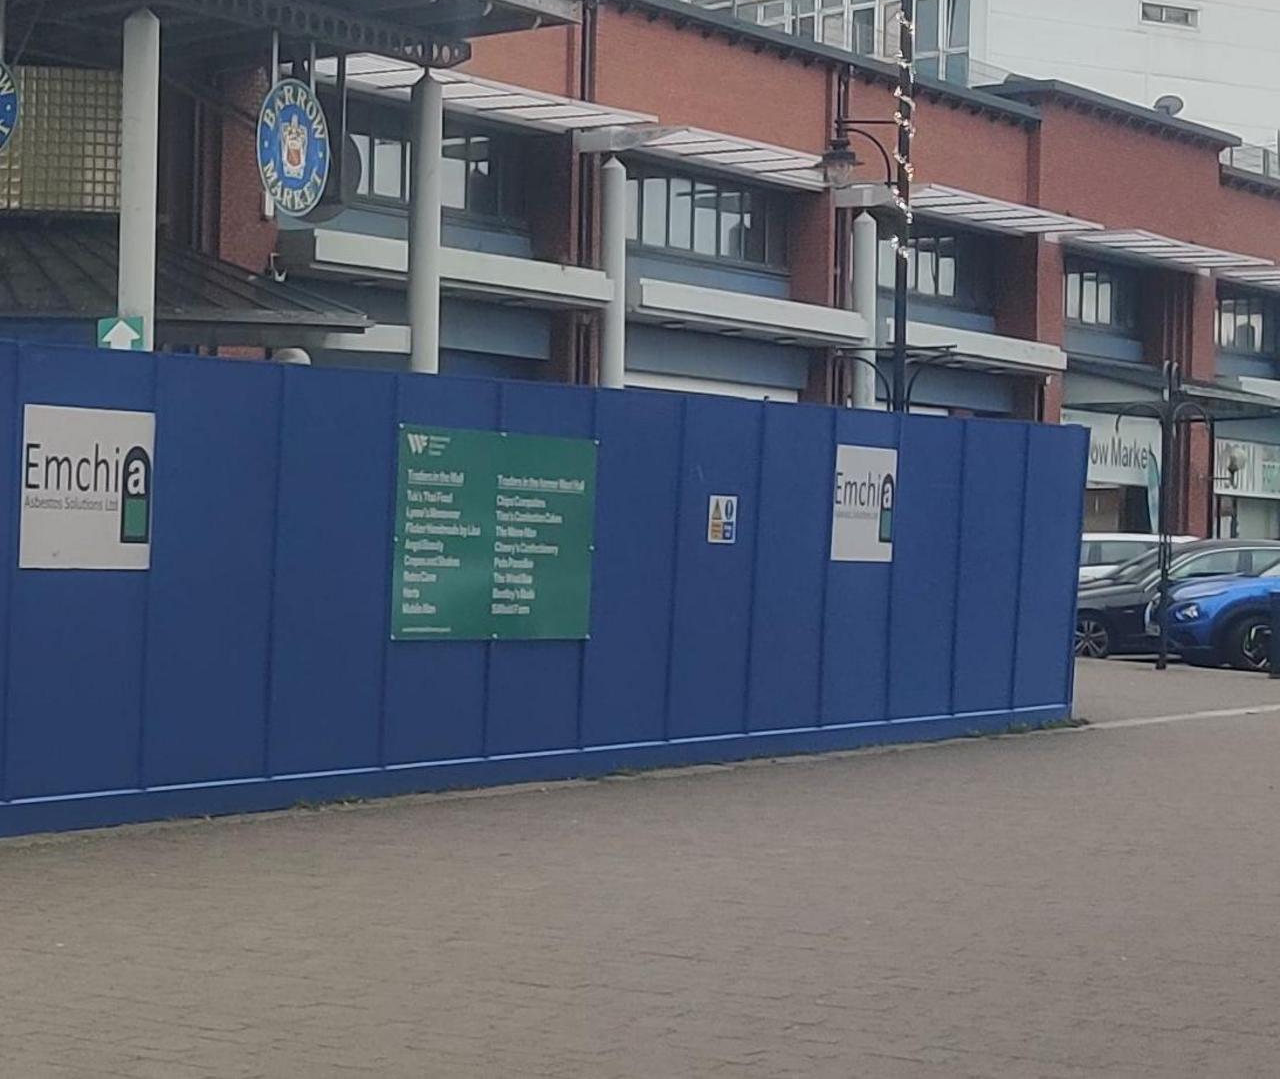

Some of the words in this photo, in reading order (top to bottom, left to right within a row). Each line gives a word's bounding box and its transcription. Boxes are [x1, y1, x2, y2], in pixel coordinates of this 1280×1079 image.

[263, 85, 325, 139] BARROW
[263, 157, 322, 209] MARKET
[24, 442, 149, 496] Emchia
[1091, 442, 1108, 466] ow
[1111, 437, 1149, 469] Marke
[64, 497, 103, 511] Solutions
[835, 471, 894, 509] Emchia
